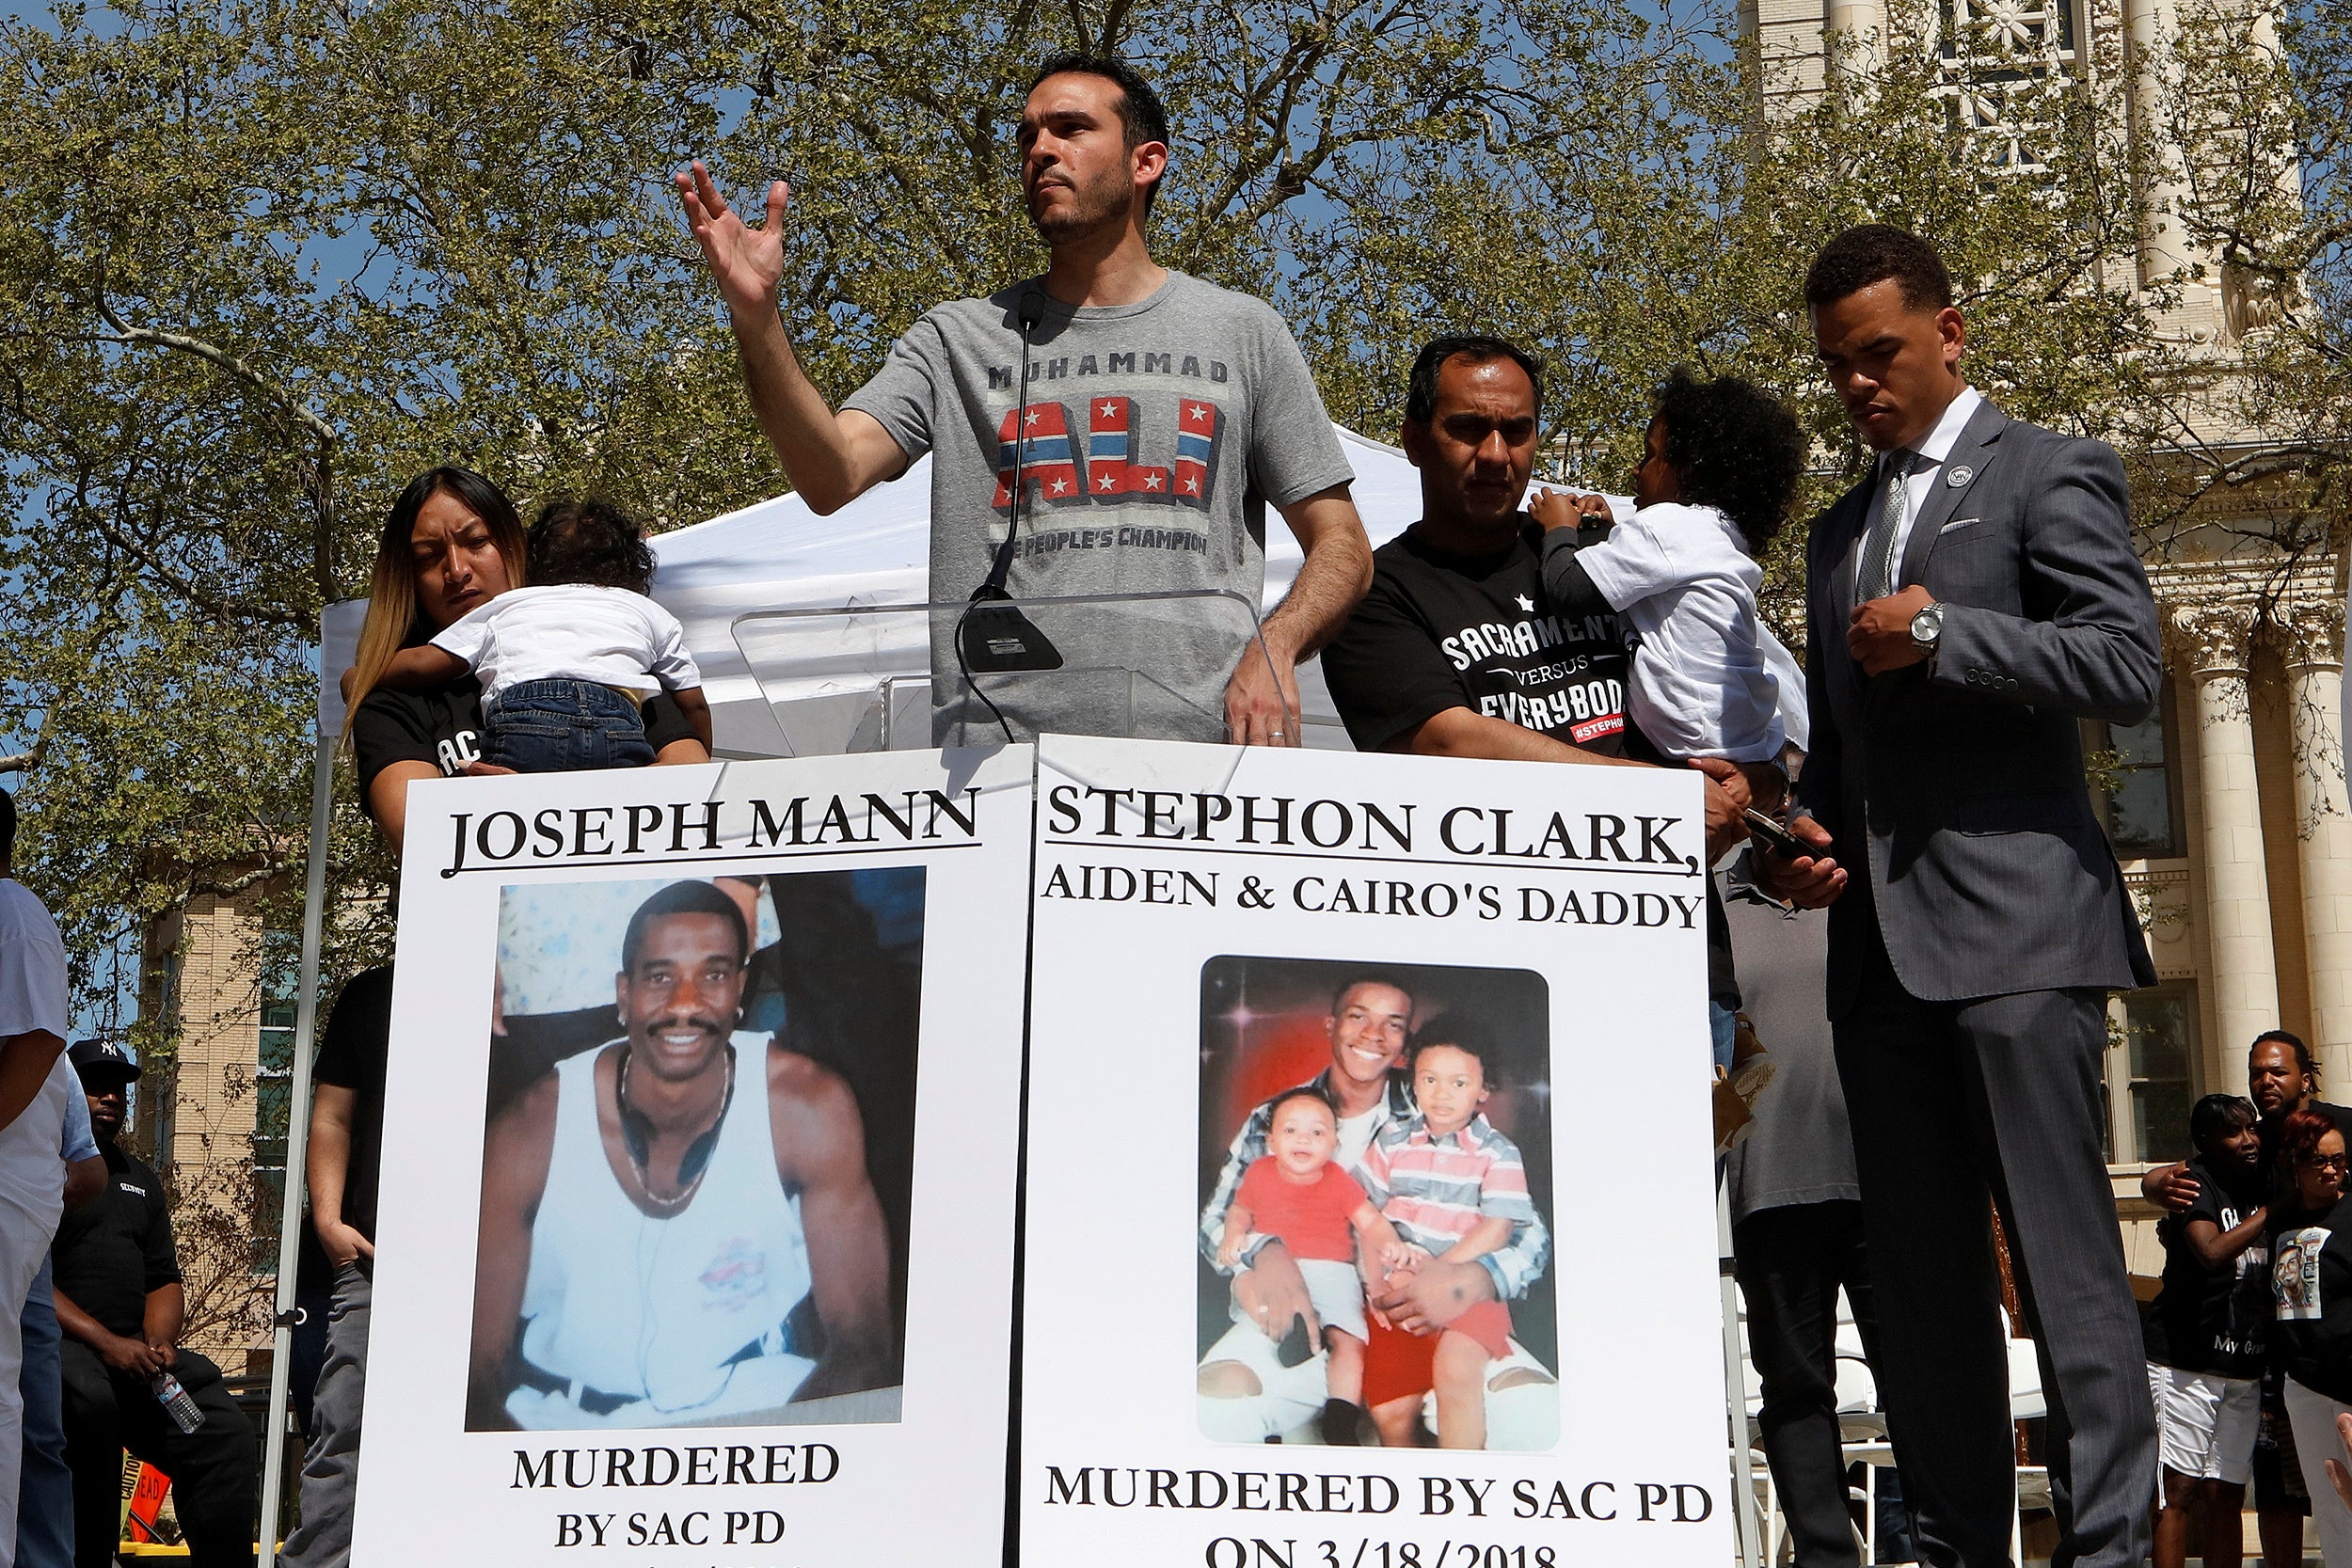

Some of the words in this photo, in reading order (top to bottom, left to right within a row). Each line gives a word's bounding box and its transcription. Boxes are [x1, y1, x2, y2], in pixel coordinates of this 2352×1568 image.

[987, 352, 1229, 390] MUHAMMAD
[991, 396, 1226, 518] ALI
[989, 539, 1023, 562] TE
[1025, 530, 1113, 558] PEOPLE'S
[1119, 527, 1208, 556] CHAMPION
[1514, 655, 1588, 687] VERSUS
[1480, 679, 1625, 731] EVERYBOD
[440, 801, 725, 879] JOSEPH
[744, 787, 982, 848] MANN
[1048, 785, 1416, 853] STEPHON
[1439, 807, 1699, 878] CLARK,
[1040, 864, 1219, 907] AIDEN
[1237, 875, 1276, 910] &
[1293, 877, 1502, 920] CAIRO'S
[1517, 888, 1705, 929] DADDY
[120, 1454, 141, 1499] CAUTIO
[510, 1444, 839, 1489] MURDERED
[1043, 1466, 1400, 1514] MURDERED
[1420, 1478, 1497, 1517] BY
[1513, 1480, 1617, 1521] SAC
[1635, 1483, 1713, 1523] PD
[554, 1513, 617, 1547] BY
[627, 1513, 709, 1546] SAC
[723, 1511, 785, 1544] PD
[1205, 1537, 1297, 1568] ON
